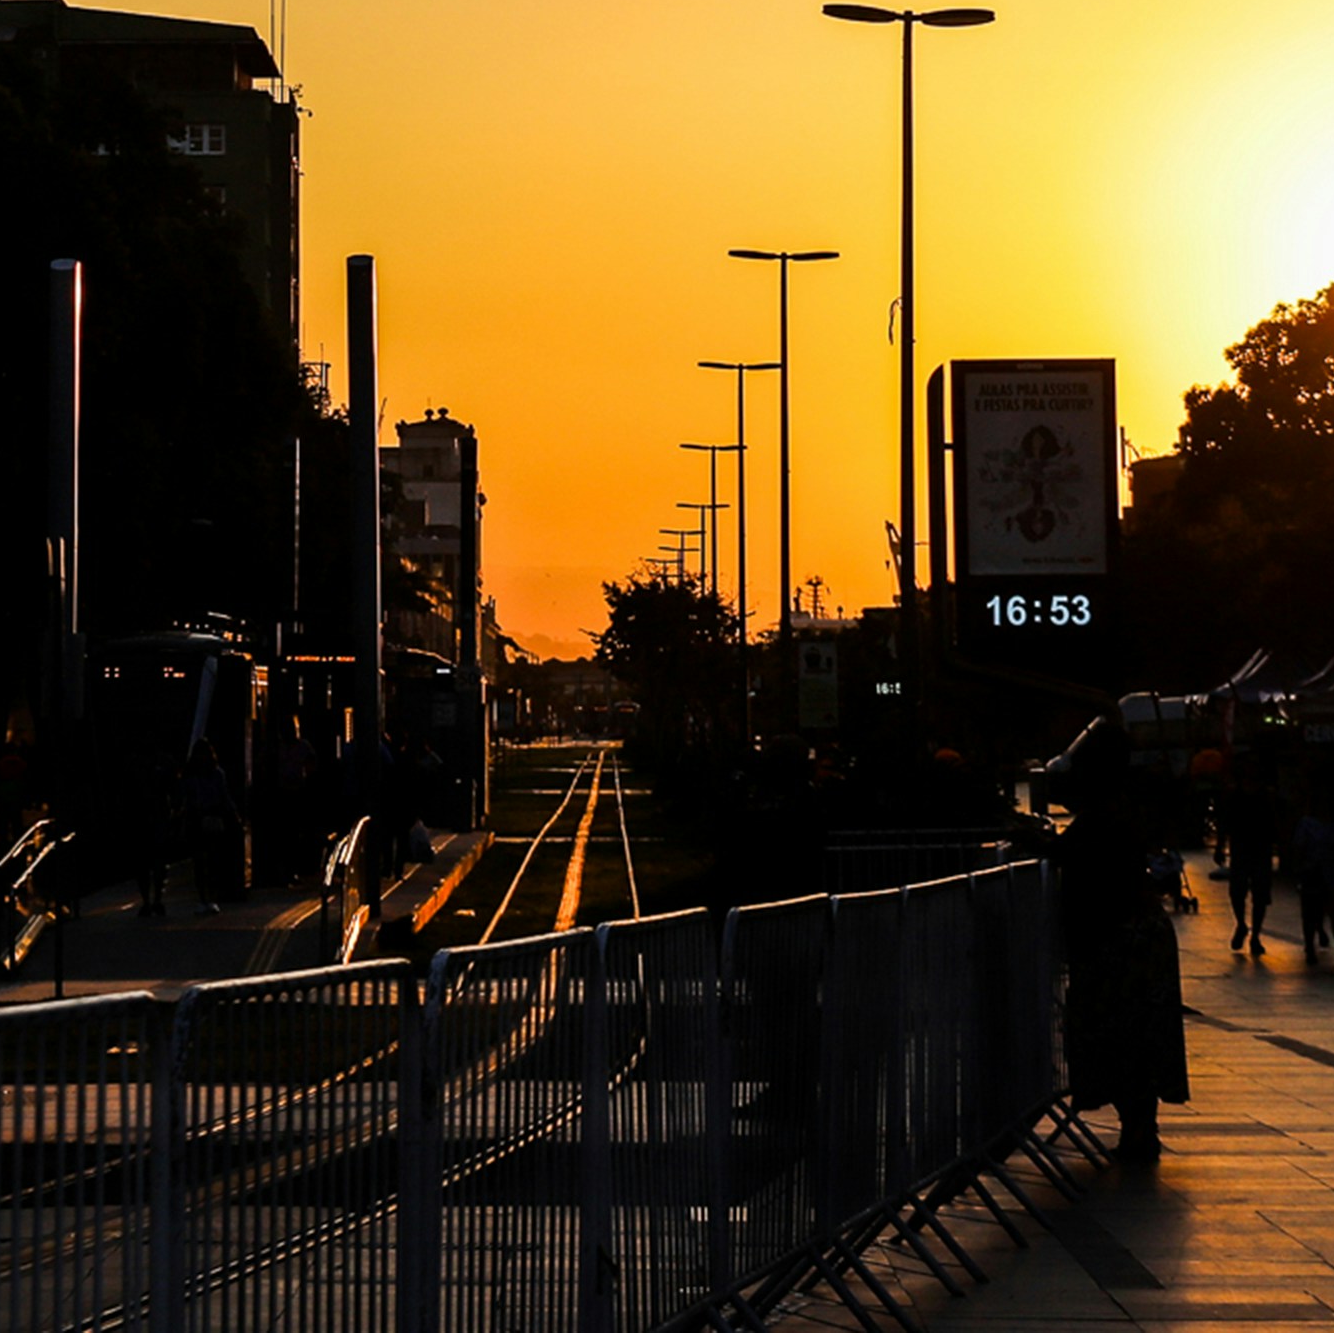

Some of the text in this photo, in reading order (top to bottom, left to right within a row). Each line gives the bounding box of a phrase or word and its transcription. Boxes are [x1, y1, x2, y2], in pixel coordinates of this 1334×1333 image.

[1016, 383, 1039, 396] PRA
[983, 398, 1020, 411] FESTAS
[1023, 398, 1046, 411] PRA
[985, 594, 1093, 628] 16:53
